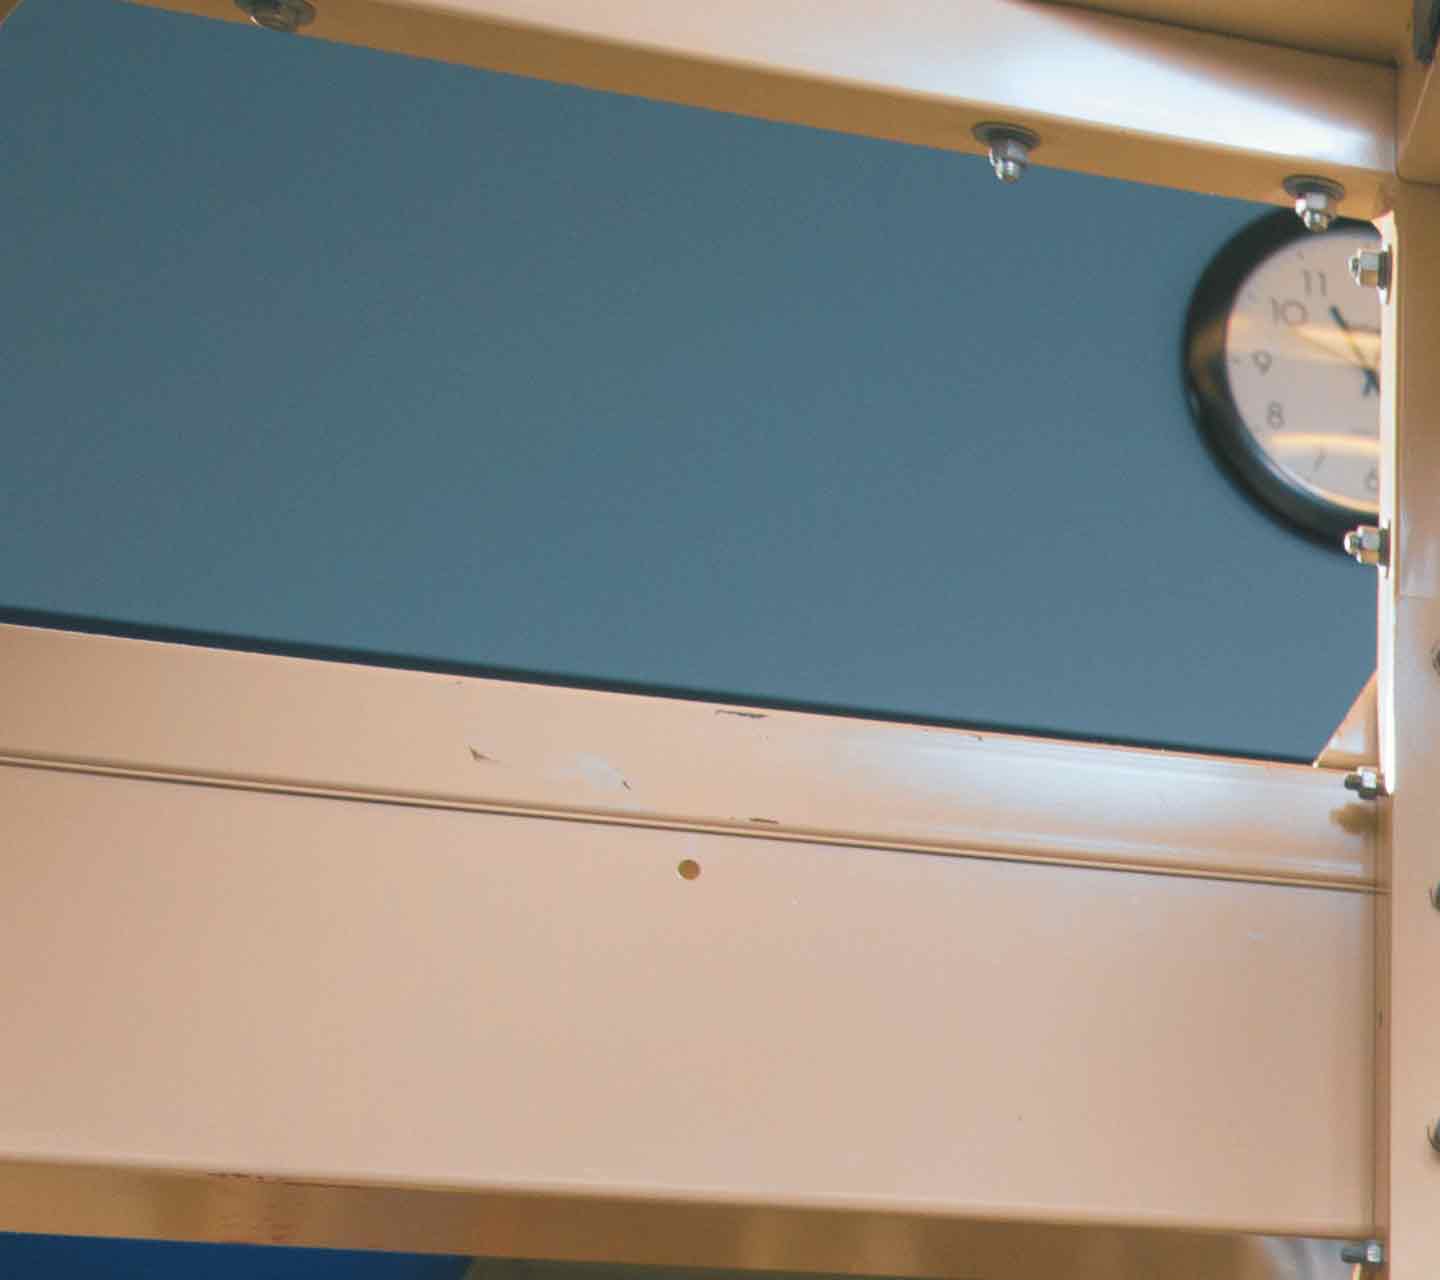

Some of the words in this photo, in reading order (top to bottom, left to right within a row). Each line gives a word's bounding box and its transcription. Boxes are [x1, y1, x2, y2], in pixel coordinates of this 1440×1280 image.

[1303, 269, 1327, 296] 11
[1269, 297, 1307, 326] 10
[1251, 350, 1273, 376] 9
[1267, 401, 1285, 429] 8
